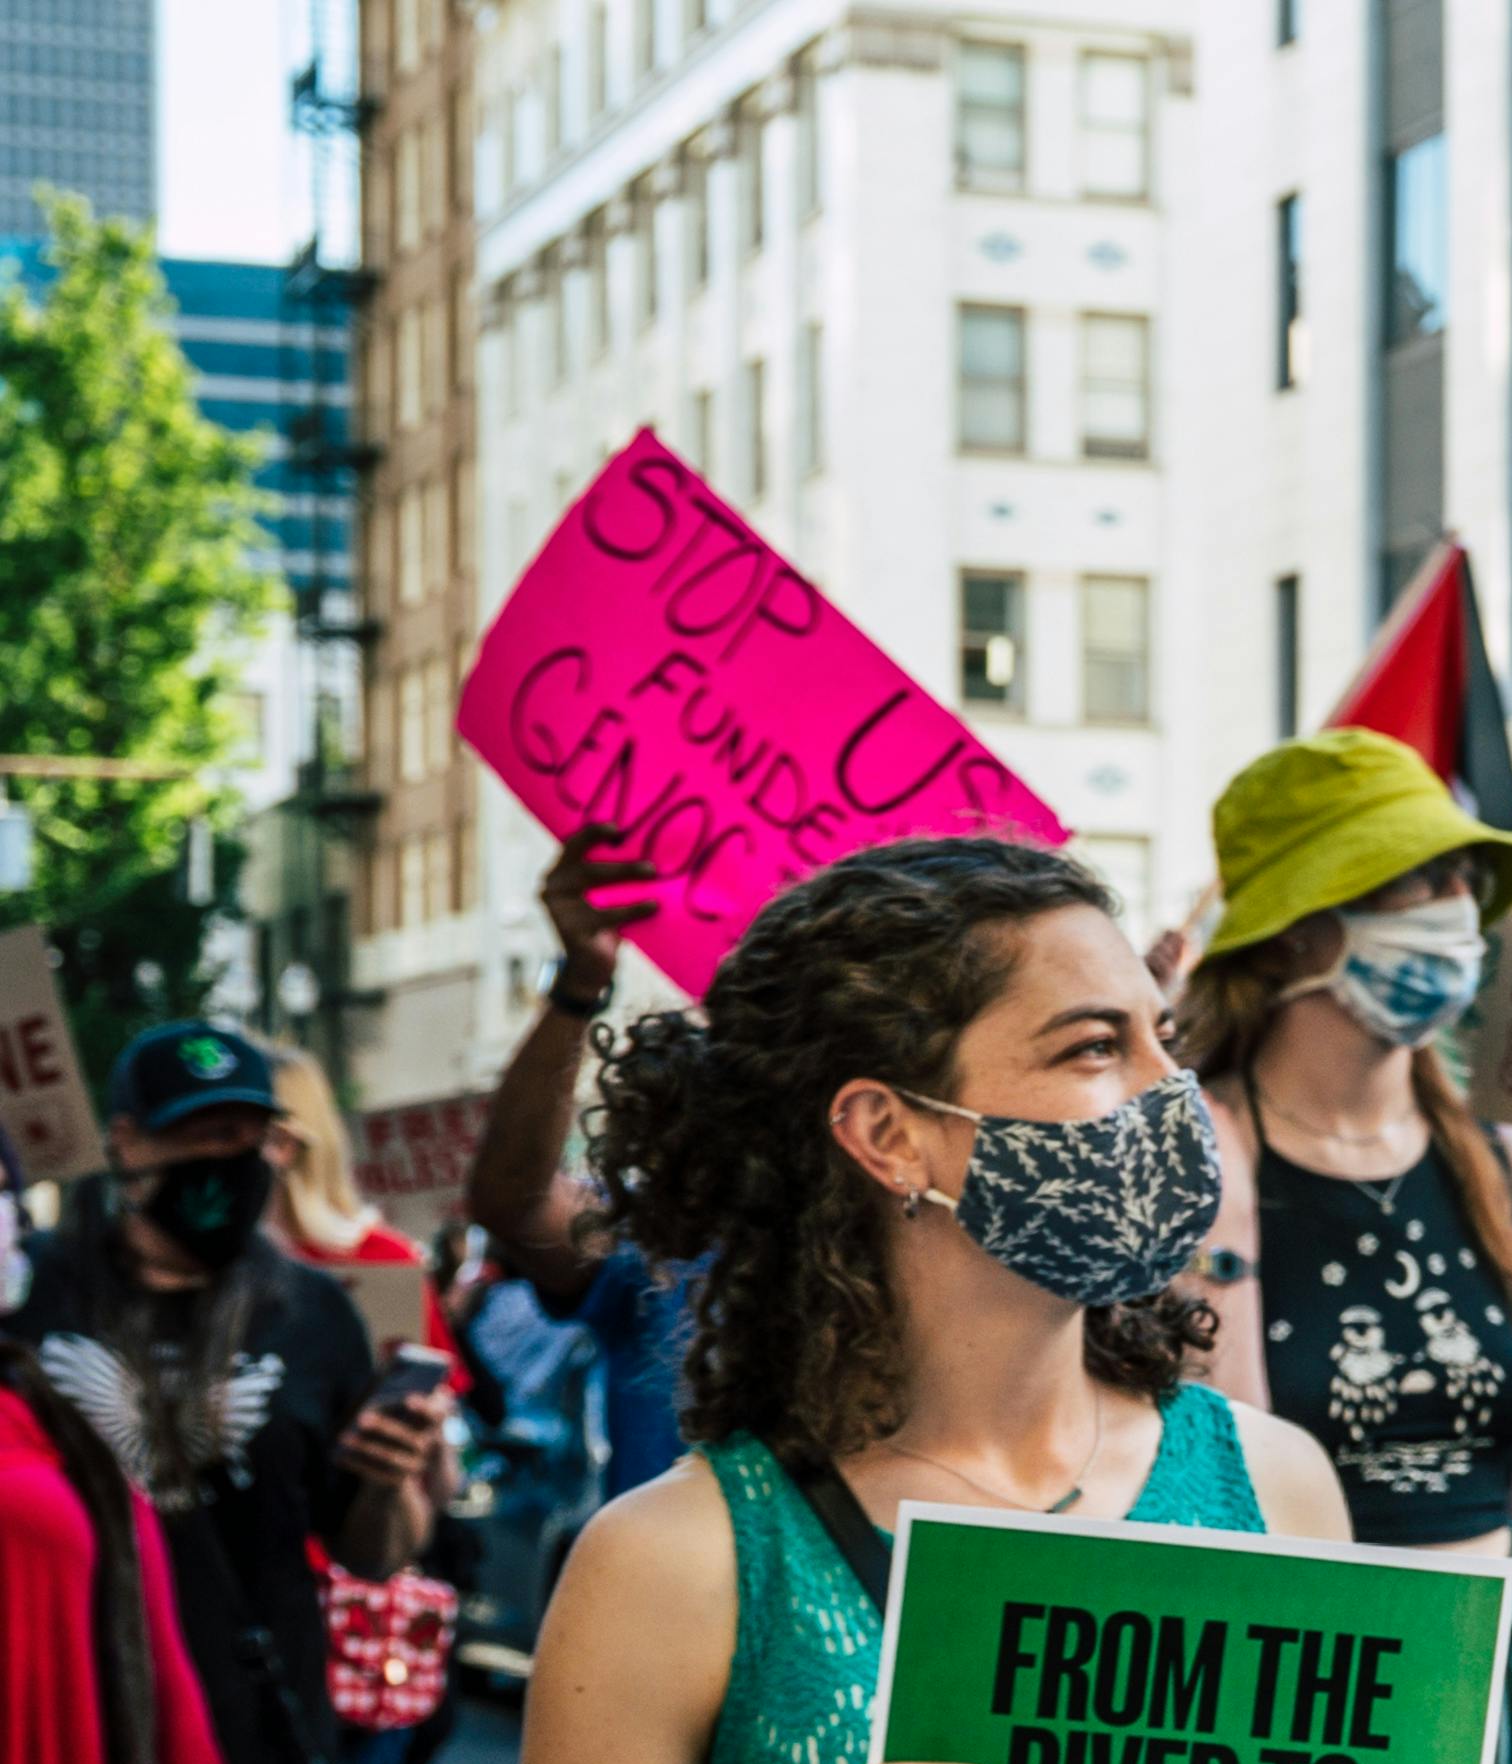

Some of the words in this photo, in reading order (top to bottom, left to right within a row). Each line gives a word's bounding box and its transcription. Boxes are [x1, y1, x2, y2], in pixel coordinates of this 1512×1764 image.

[582, 457, 824, 664] STOP
[510, 646, 775, 922] GENOC
[628, 650, 848, 868] FUNDE
[991, 1601, 1228, 1734] FROM
[1246, 1624, 1403, 1751] THE
